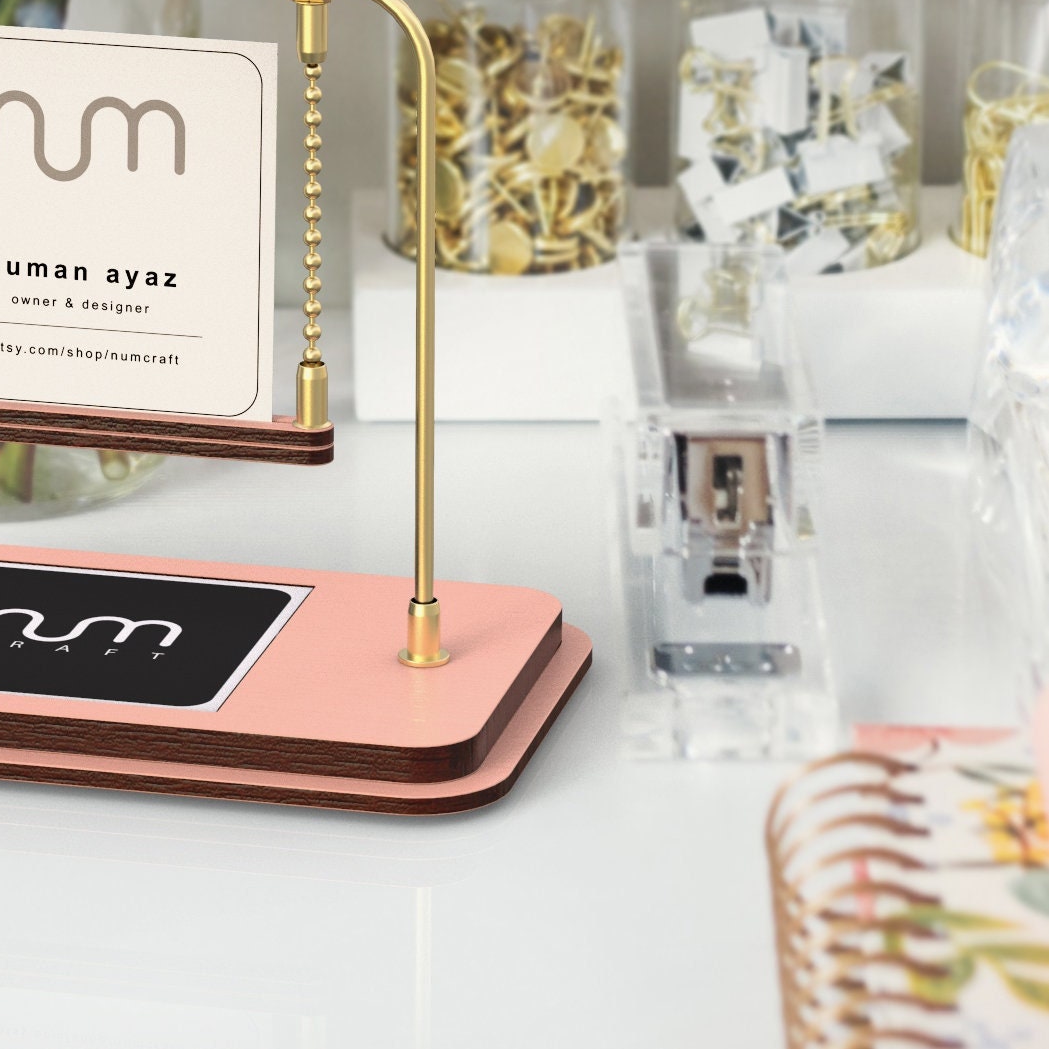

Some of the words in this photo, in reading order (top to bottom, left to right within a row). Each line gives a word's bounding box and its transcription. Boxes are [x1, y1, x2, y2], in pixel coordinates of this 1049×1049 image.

[106, 267, 177, 290] ayaz
[11, 295, 57, 307] owner
[65, 297, 74, 309] &
[81, 298, 150, 315] designer
